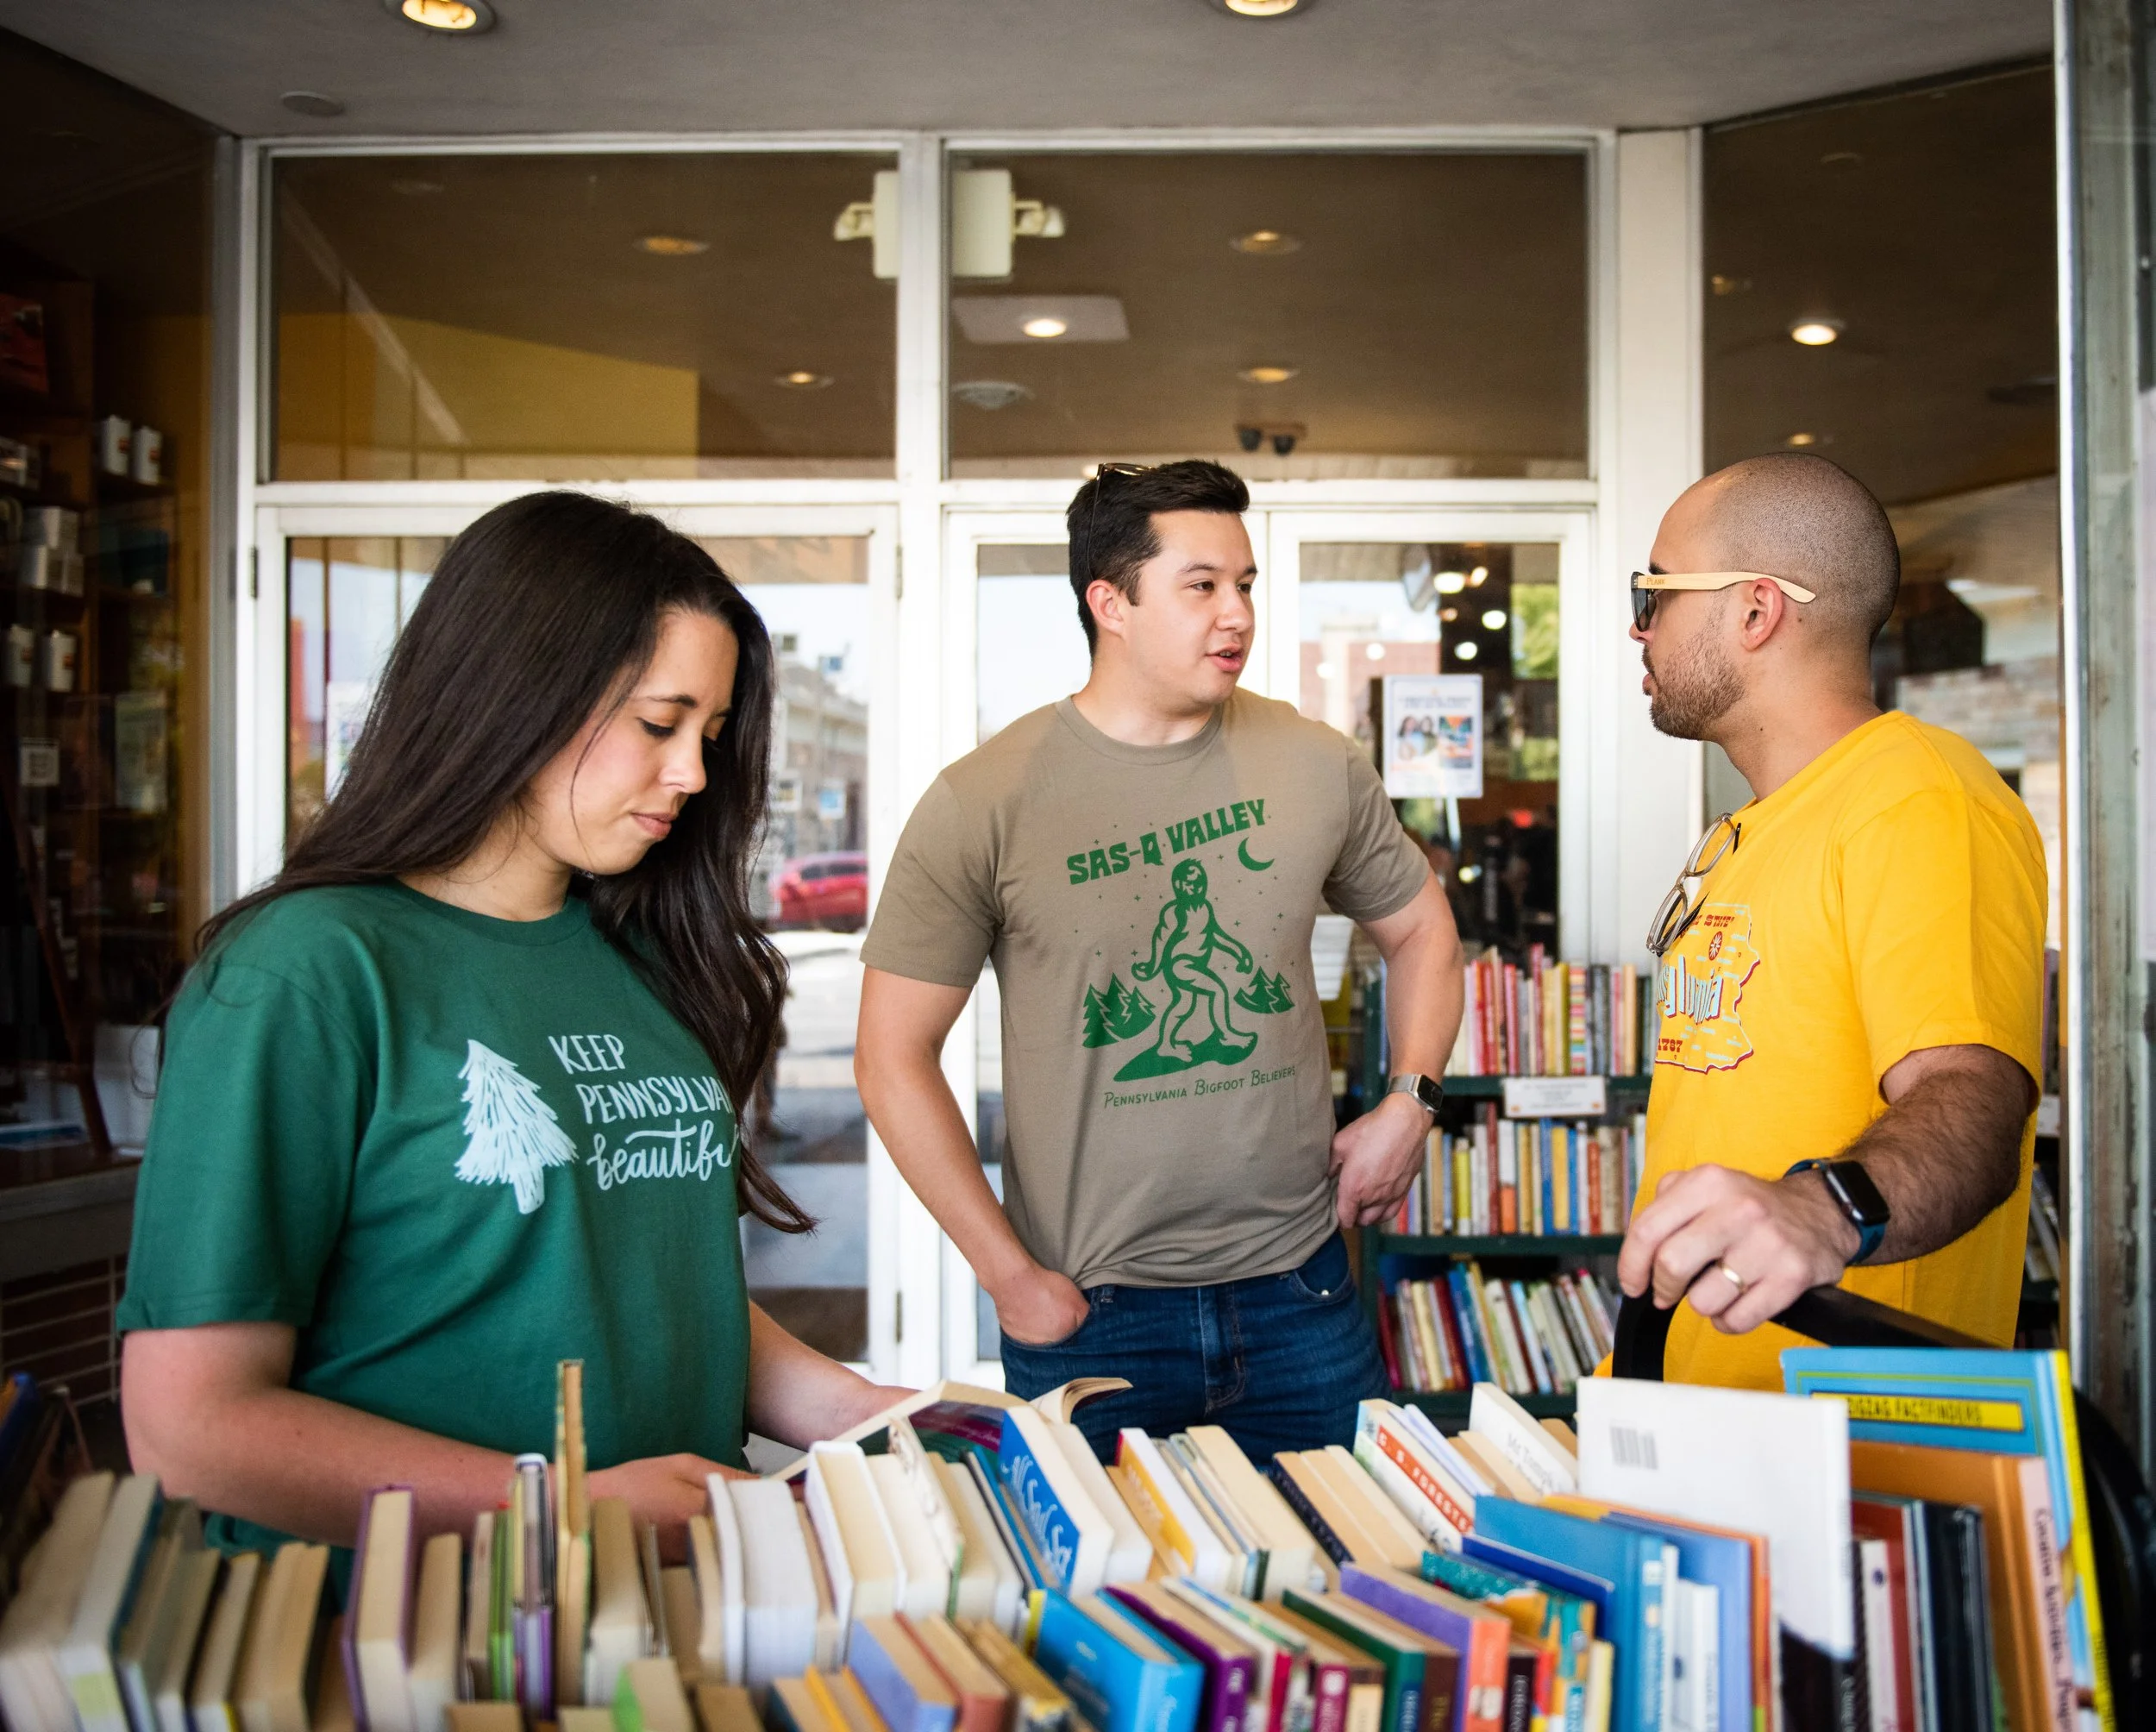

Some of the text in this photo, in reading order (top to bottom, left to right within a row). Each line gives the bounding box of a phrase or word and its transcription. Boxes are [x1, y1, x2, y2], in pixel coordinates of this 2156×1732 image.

[1066, 799, 1265, 885] SAS-Q VALLEY
[548, 1033, 626, 1075] KEEP
[575, 1076, 733, 1125] PENNSYLVA
[1104, 1088, 1188, 1108] PENNSYLVANIA
[1194, 1078, 1245, 1096] BIGFOOT
